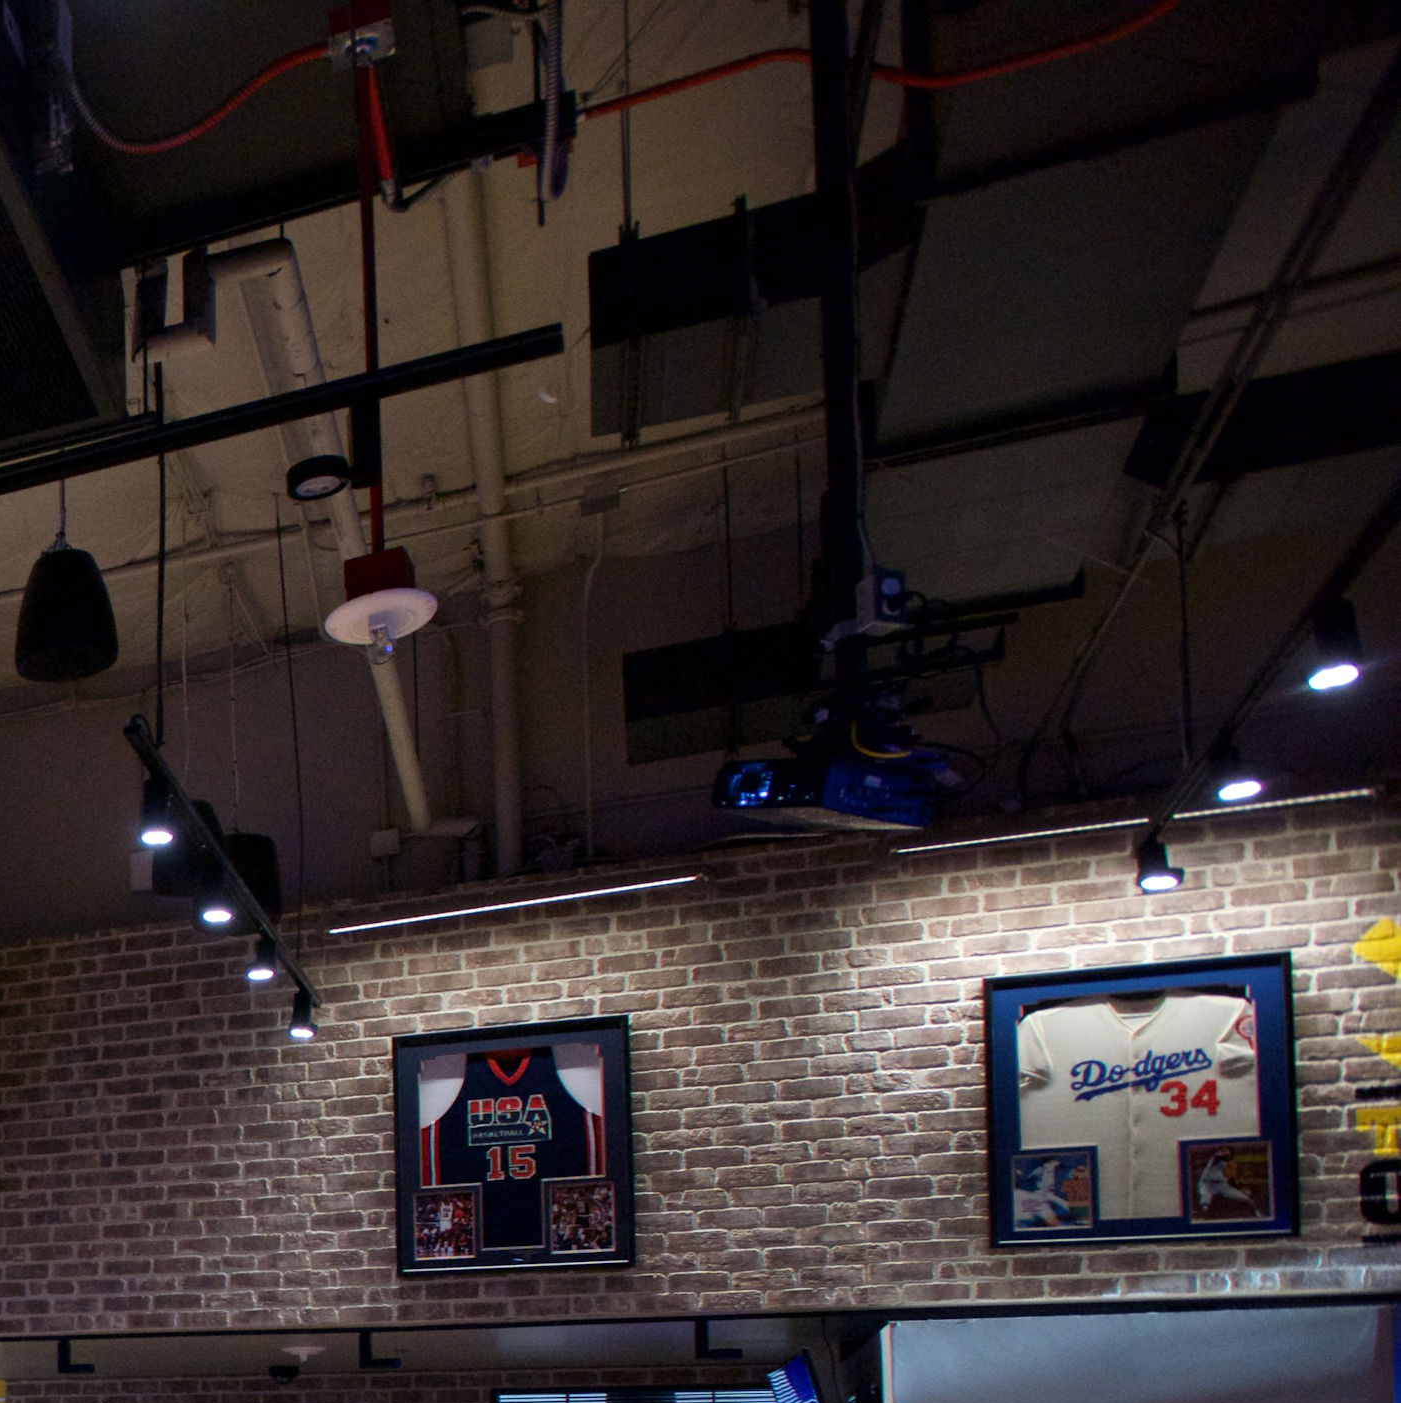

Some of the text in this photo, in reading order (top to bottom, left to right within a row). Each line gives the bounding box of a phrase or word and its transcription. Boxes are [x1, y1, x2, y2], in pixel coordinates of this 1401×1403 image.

[1070, 1048, 1212, 1101] Dodgers
[468, 1094, 552, 1134] USA
[1159, 1080, 1220, 1117] 34
[486, 1144, 537, 1181] 15
